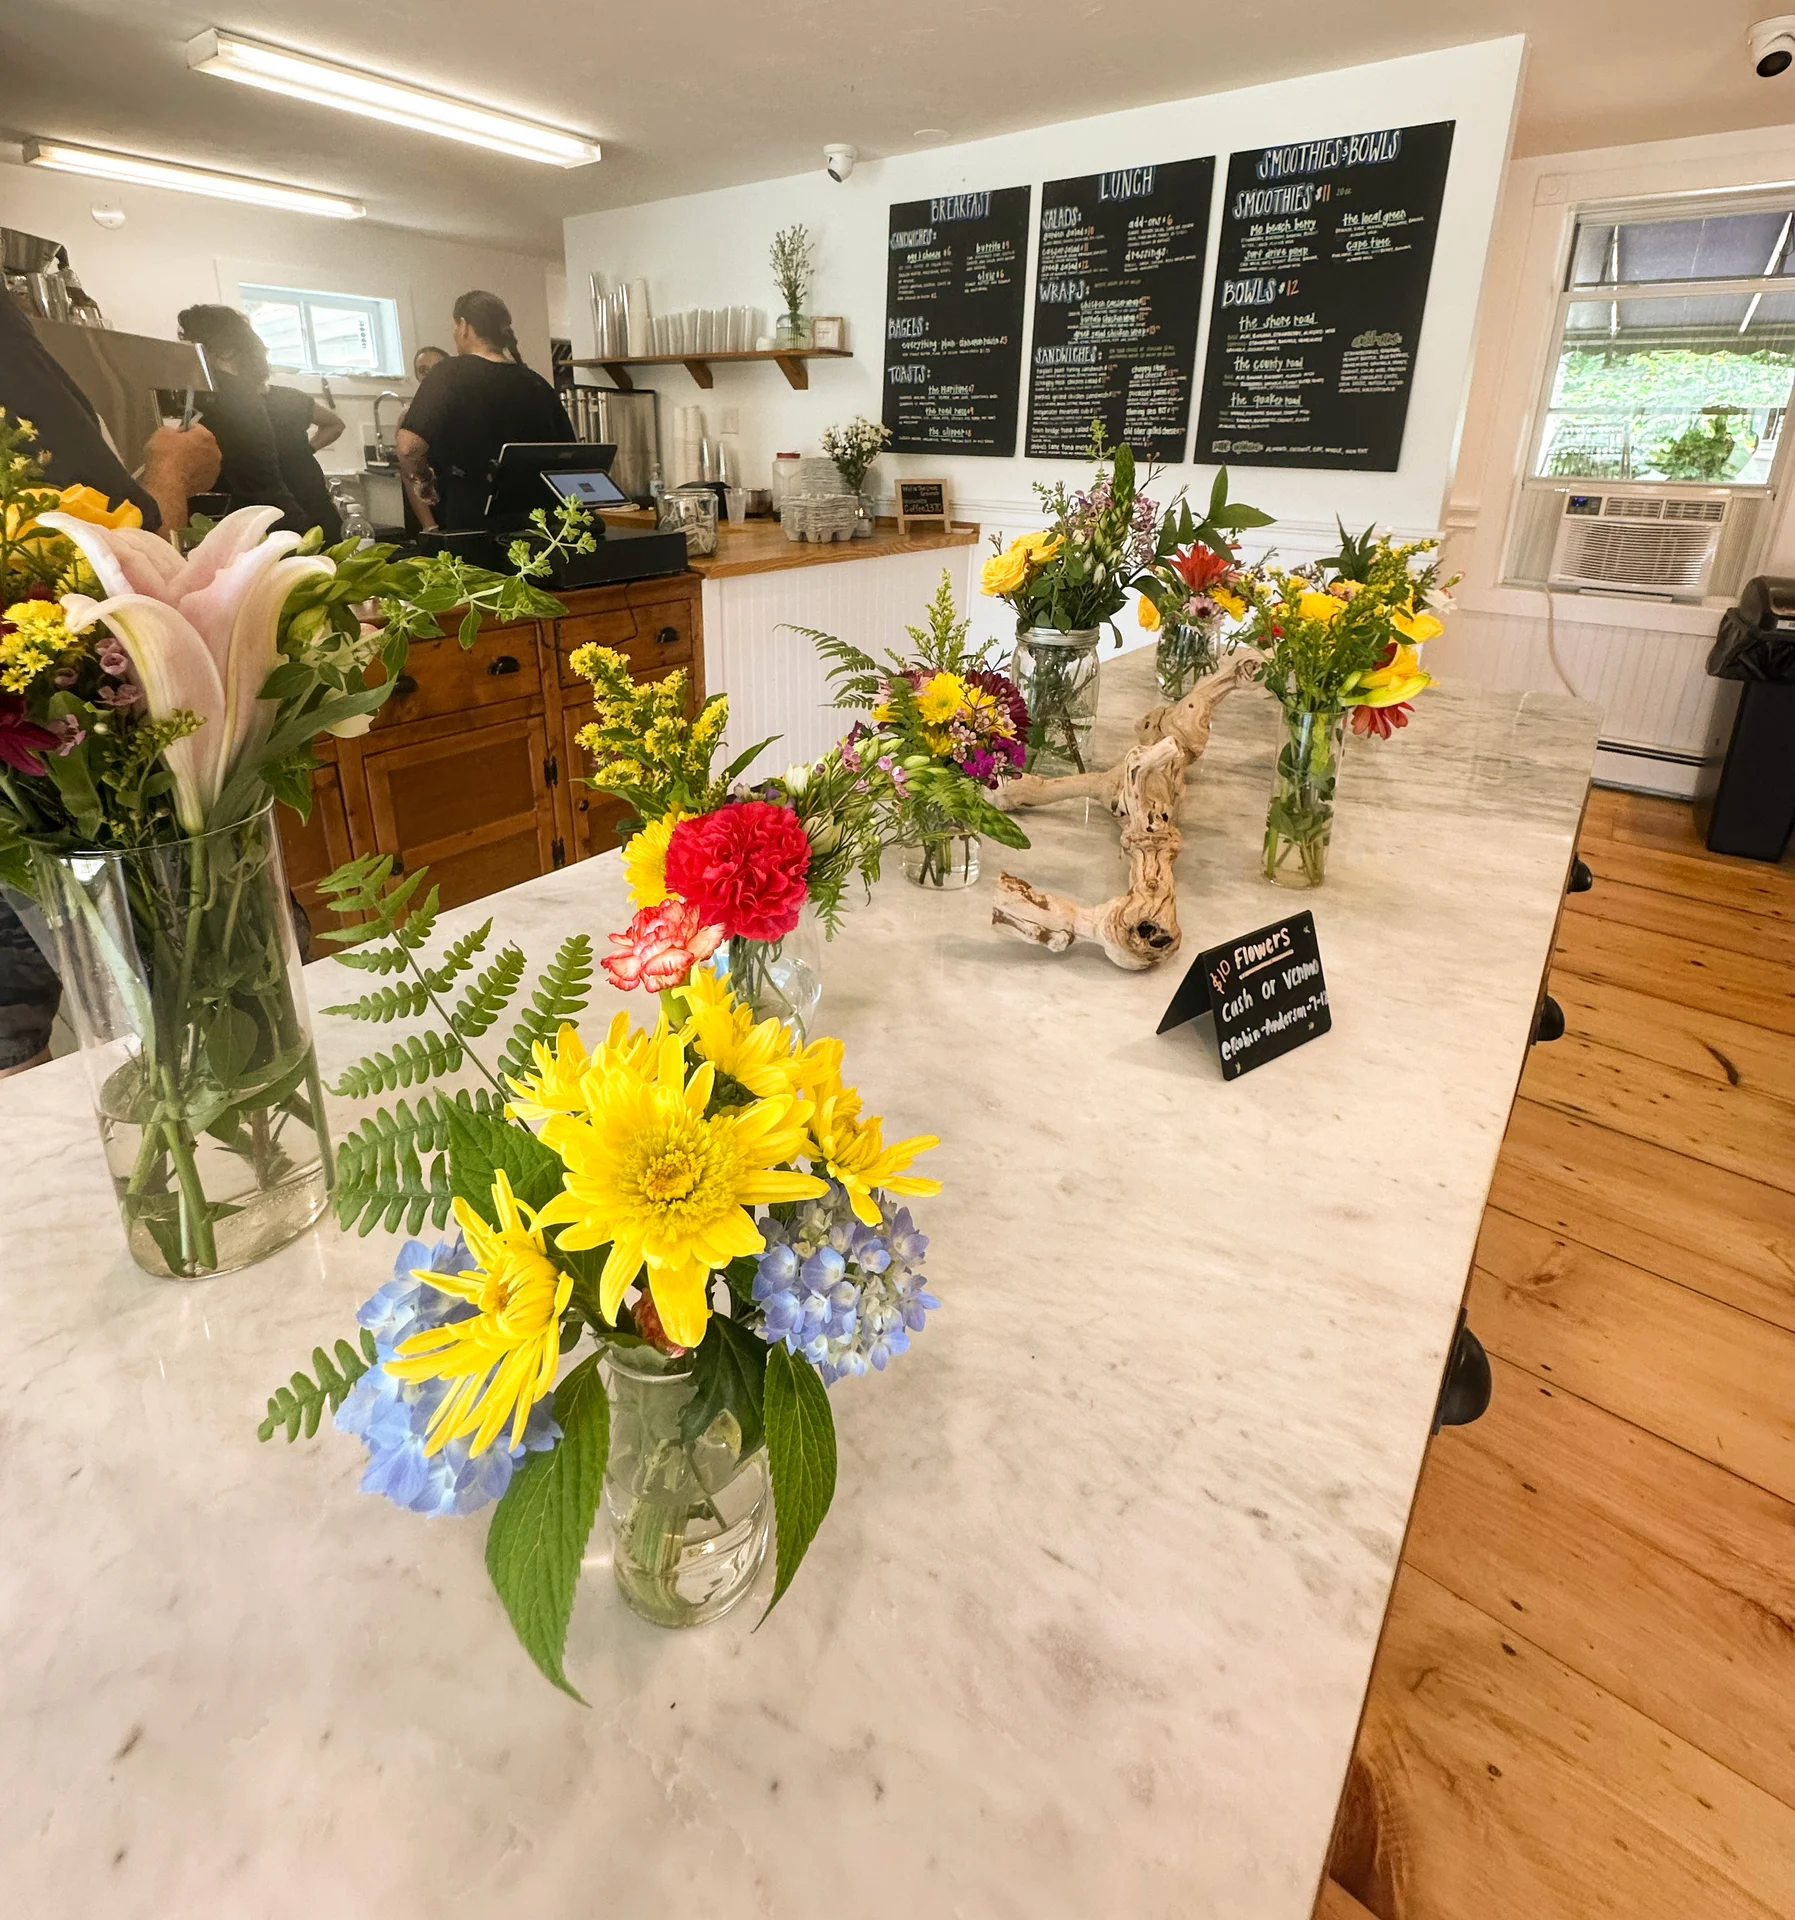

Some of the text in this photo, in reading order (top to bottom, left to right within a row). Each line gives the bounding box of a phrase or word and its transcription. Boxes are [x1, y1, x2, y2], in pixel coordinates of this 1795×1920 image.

[1258, 139, 1342, 179] SMOOTHIES
[1348, 130, 1400, 166] BOWLS
[1100, 166, 1154, 201] LUNCH
[930, 192, 992, 223] BREAKFAST
[1232, 184, 1314, 219] SMOOTHIES
[1315, 184, 1331, 202] $11
[1266, 219, 1291, 234] beach
[1294, 218, 1316, 232] berry
[1342, 209, 1407, 226] the local green
[1066, 227, 1084, 240] salad
[976, 242, 1002, 254] burrito
[1065, 244, 1080, 255] salad
[1266, 248, 1287, 260] drive
[1060, 261, 1079, 272] salad
[1039, 280, 1090, 304] WRAPS:
[1222, 278, 1300, 308] BOWLS $12
[888, 316, 930, 340] BAGELS:
[1238, 312, 1318, 332] the shore road
[1130, 328, 1147, 338] wrap
[902, 338, 938, 352] everything
[1035, 346, 1102, 366] SANDWICHES:
[1233, 356, 1304, 373] the county road
[888, 364, 931, 385] TOASTS:
[928, 384, 940, 395] the
[1230, 392, 1302, 408] the quaker road
[924, 406, 936, 416] the
[928, 426, 965, 438] the clipper
[1234, 927, 1291, 970] Flowers
[1210, 959, 1231, 995] $10
[1222, 988, 1254, 1023] Cash
